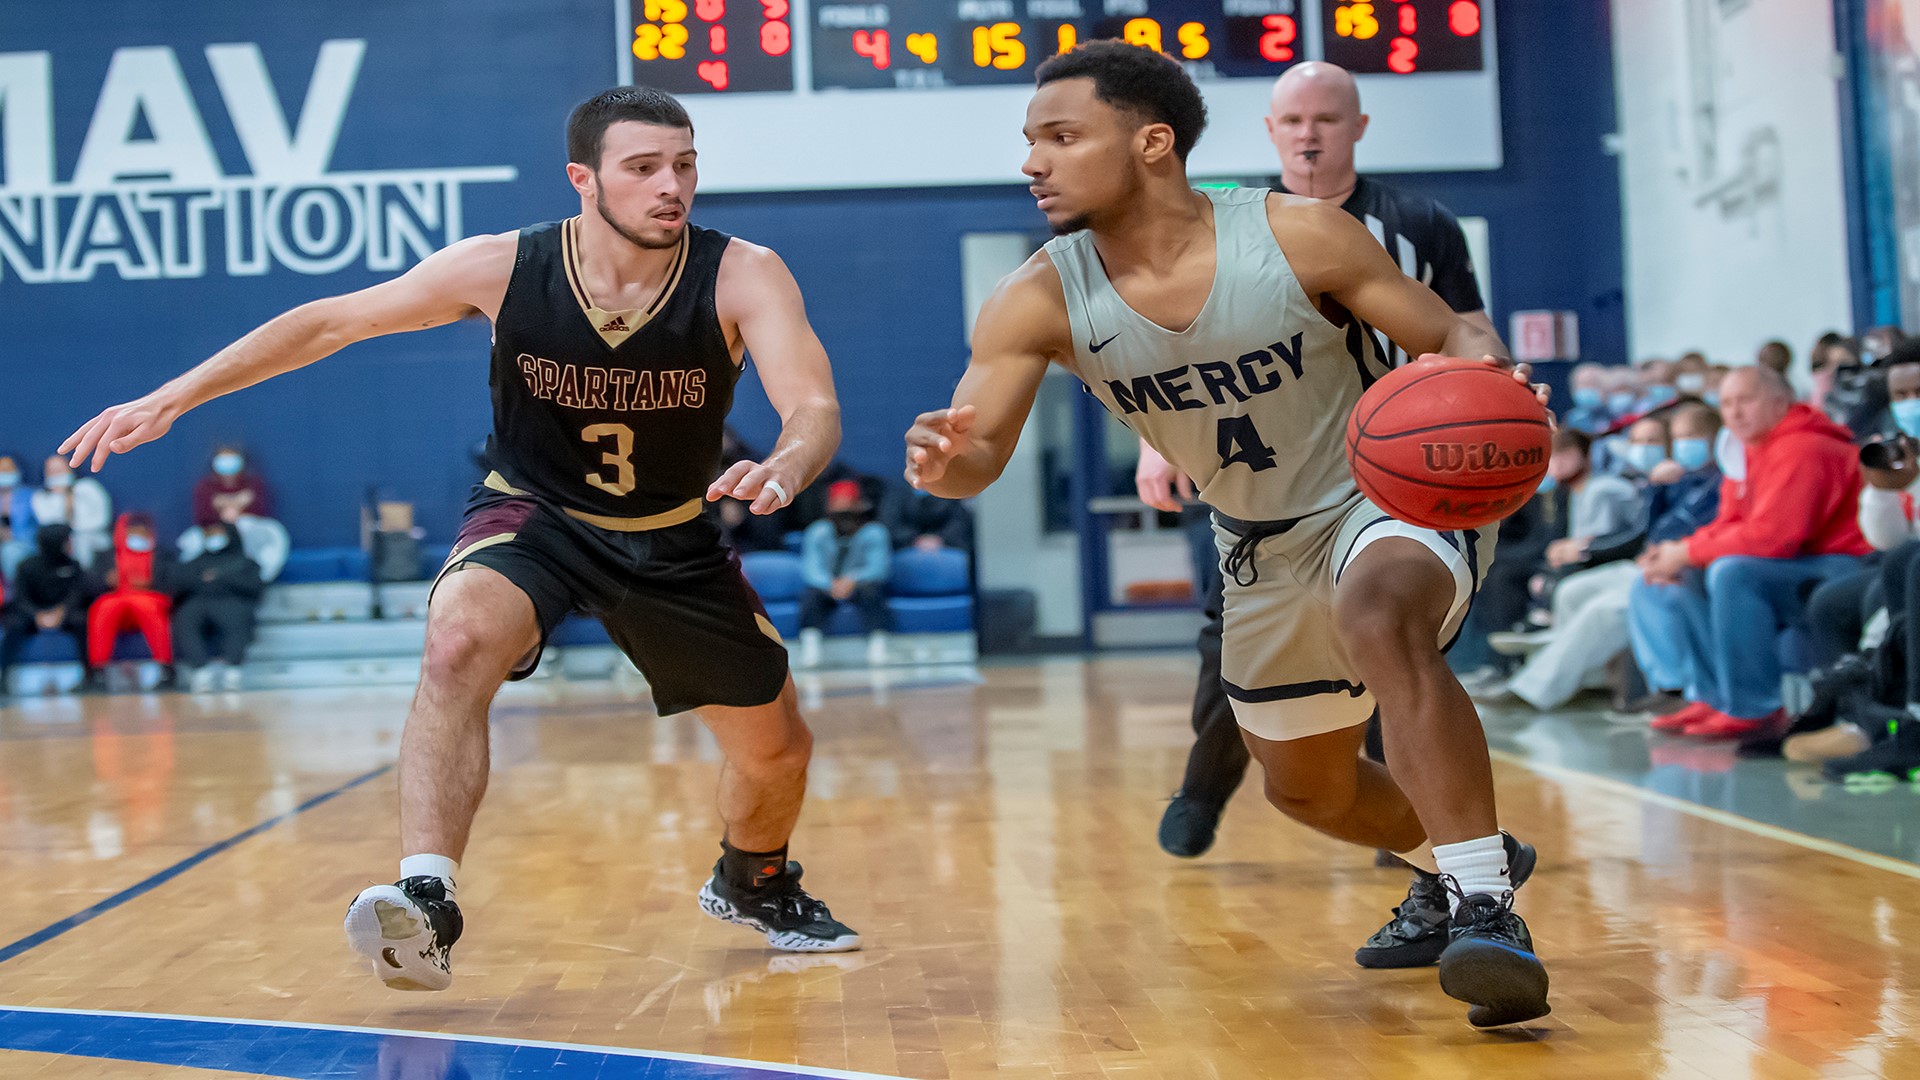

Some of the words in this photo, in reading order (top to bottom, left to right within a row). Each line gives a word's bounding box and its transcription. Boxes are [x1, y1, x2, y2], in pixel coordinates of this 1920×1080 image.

[632, 23, 689, 60] 22
[709, 24, 727, 54] 1
[852, 29, 891, 70] 4
[972, 22, 1026, 70] 15
[1259, 14, 1296, 62] 2
[1387, 36, 1419, 74] 2
[517, 353, 706, 411] SPARTANS
[1103, 331, 1304, 414] MERCY
[581, 423, 636, 496] 3
[1217, 413, 1277, 472] 4
[1421, 442, 1545, 474] Wilson
